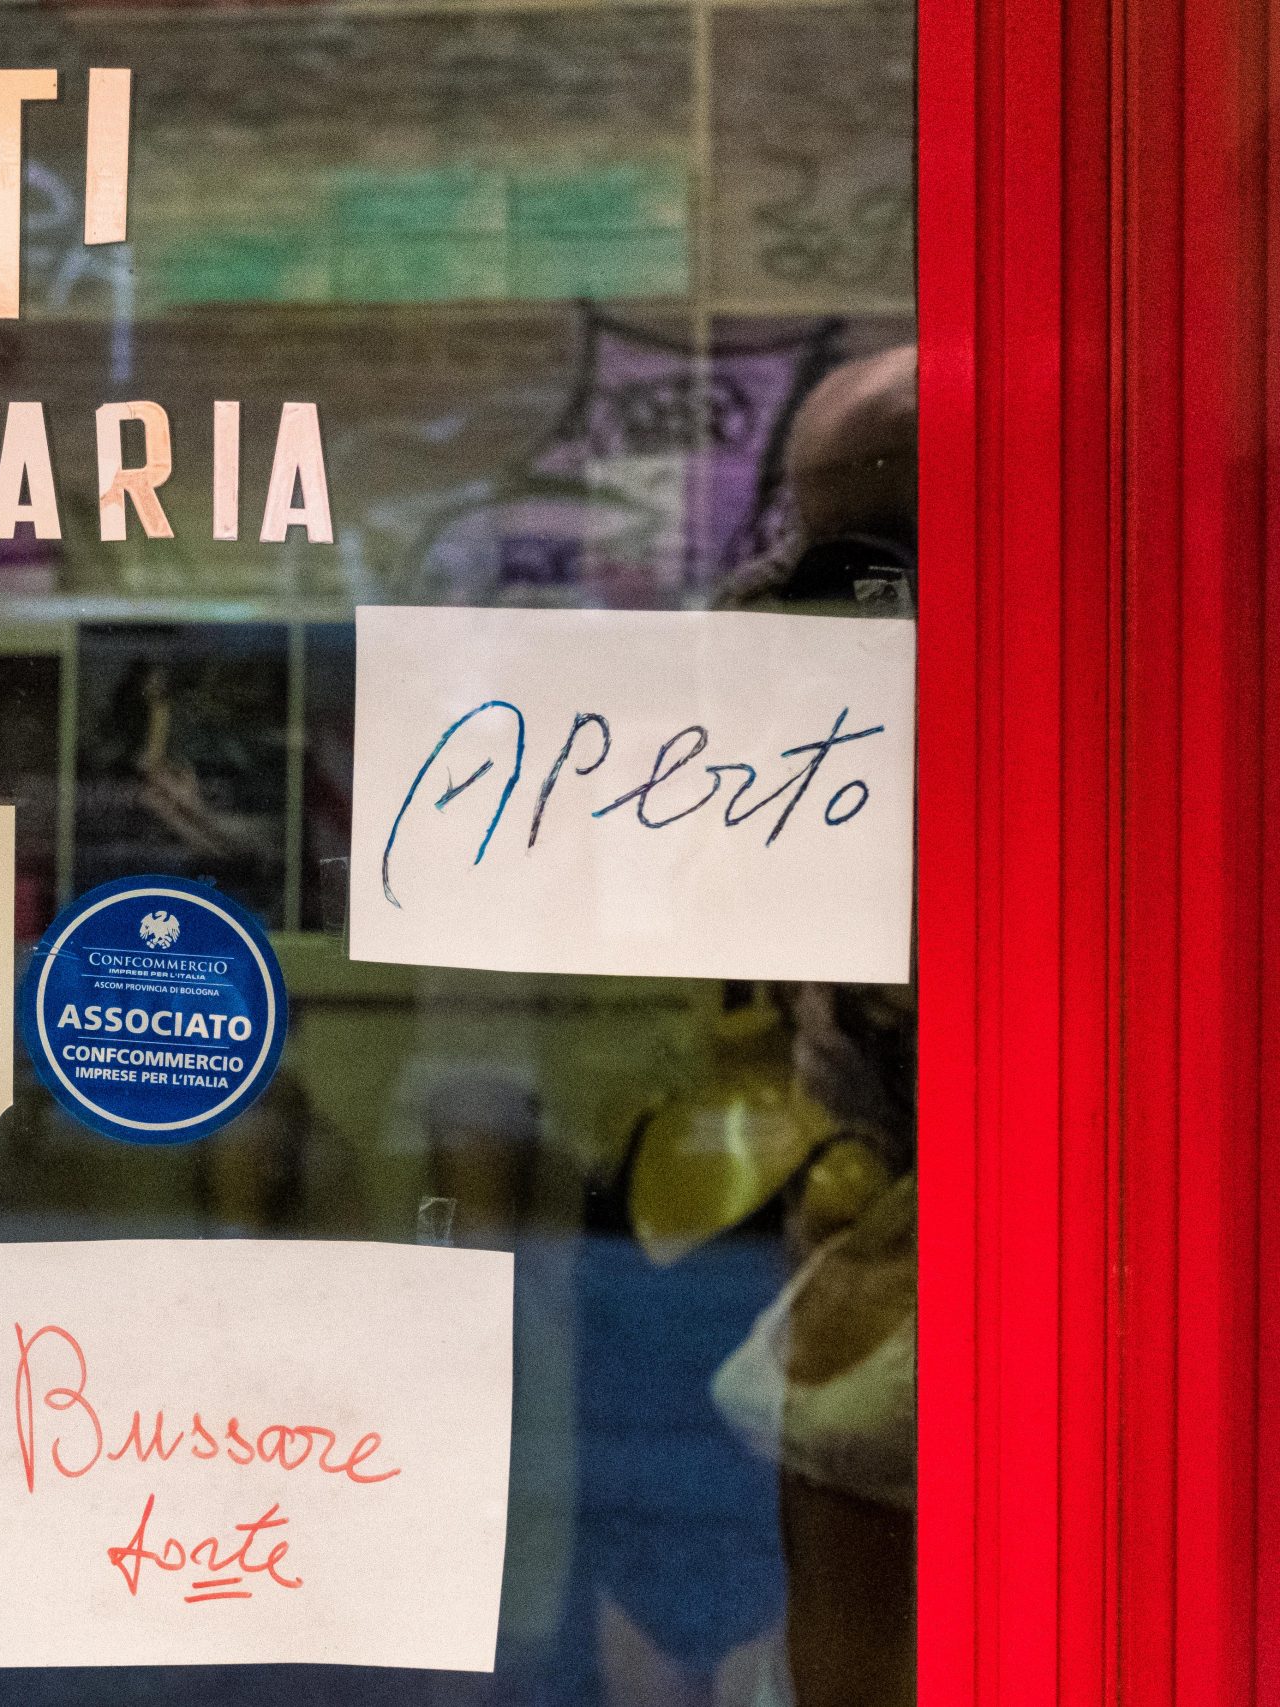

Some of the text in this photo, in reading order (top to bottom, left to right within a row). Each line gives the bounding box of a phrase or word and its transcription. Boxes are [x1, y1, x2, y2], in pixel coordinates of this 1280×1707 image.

[94, 981, 123, 990] ASCOM
[125, 983, 167, 993] PROVINCIA
[180, 987, 219, 996] BOLOGNA
[108, 968, 149, 977] IMPRESE
[169, 973, 206, 981] L'ITALIA
[57, 1004, 252, 1042] ASSOCIATO
[62, 1044, 244, 1073] CONFCOMMERCIO
[75, 1066, 229, 1089] IMPRESE PER L'ITALIA
[14, 1322, 402, 1493] Bussare
[107, 1493, 303, 1596] forte
